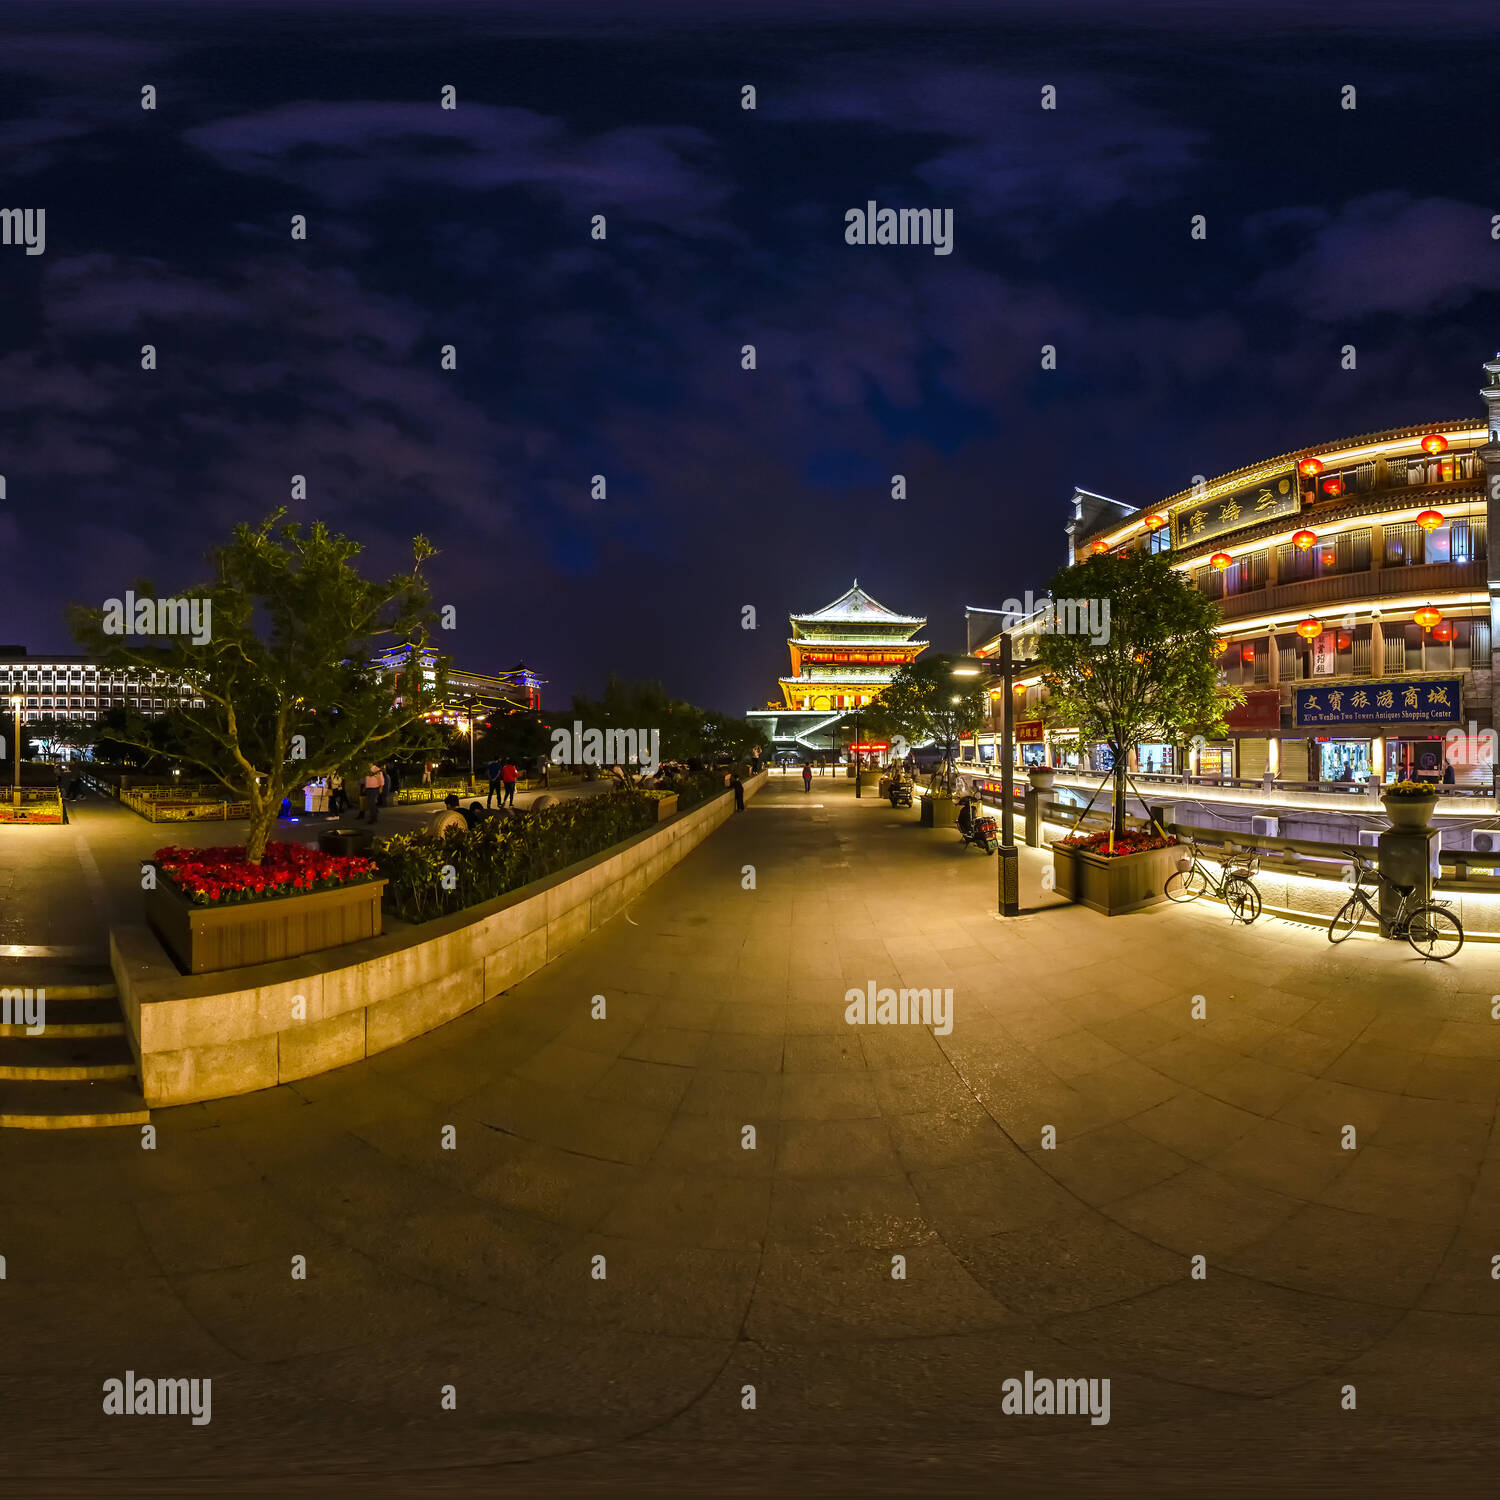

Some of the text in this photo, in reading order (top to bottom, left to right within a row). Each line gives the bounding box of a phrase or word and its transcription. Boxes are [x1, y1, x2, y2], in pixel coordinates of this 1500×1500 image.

[1354, 712, 1374, 720] Towers
[1375, 711, 1400, 721] Antiques
[1401, 710, 1429, 720] Shopping
[1431, 710, 1451, 718] Center
